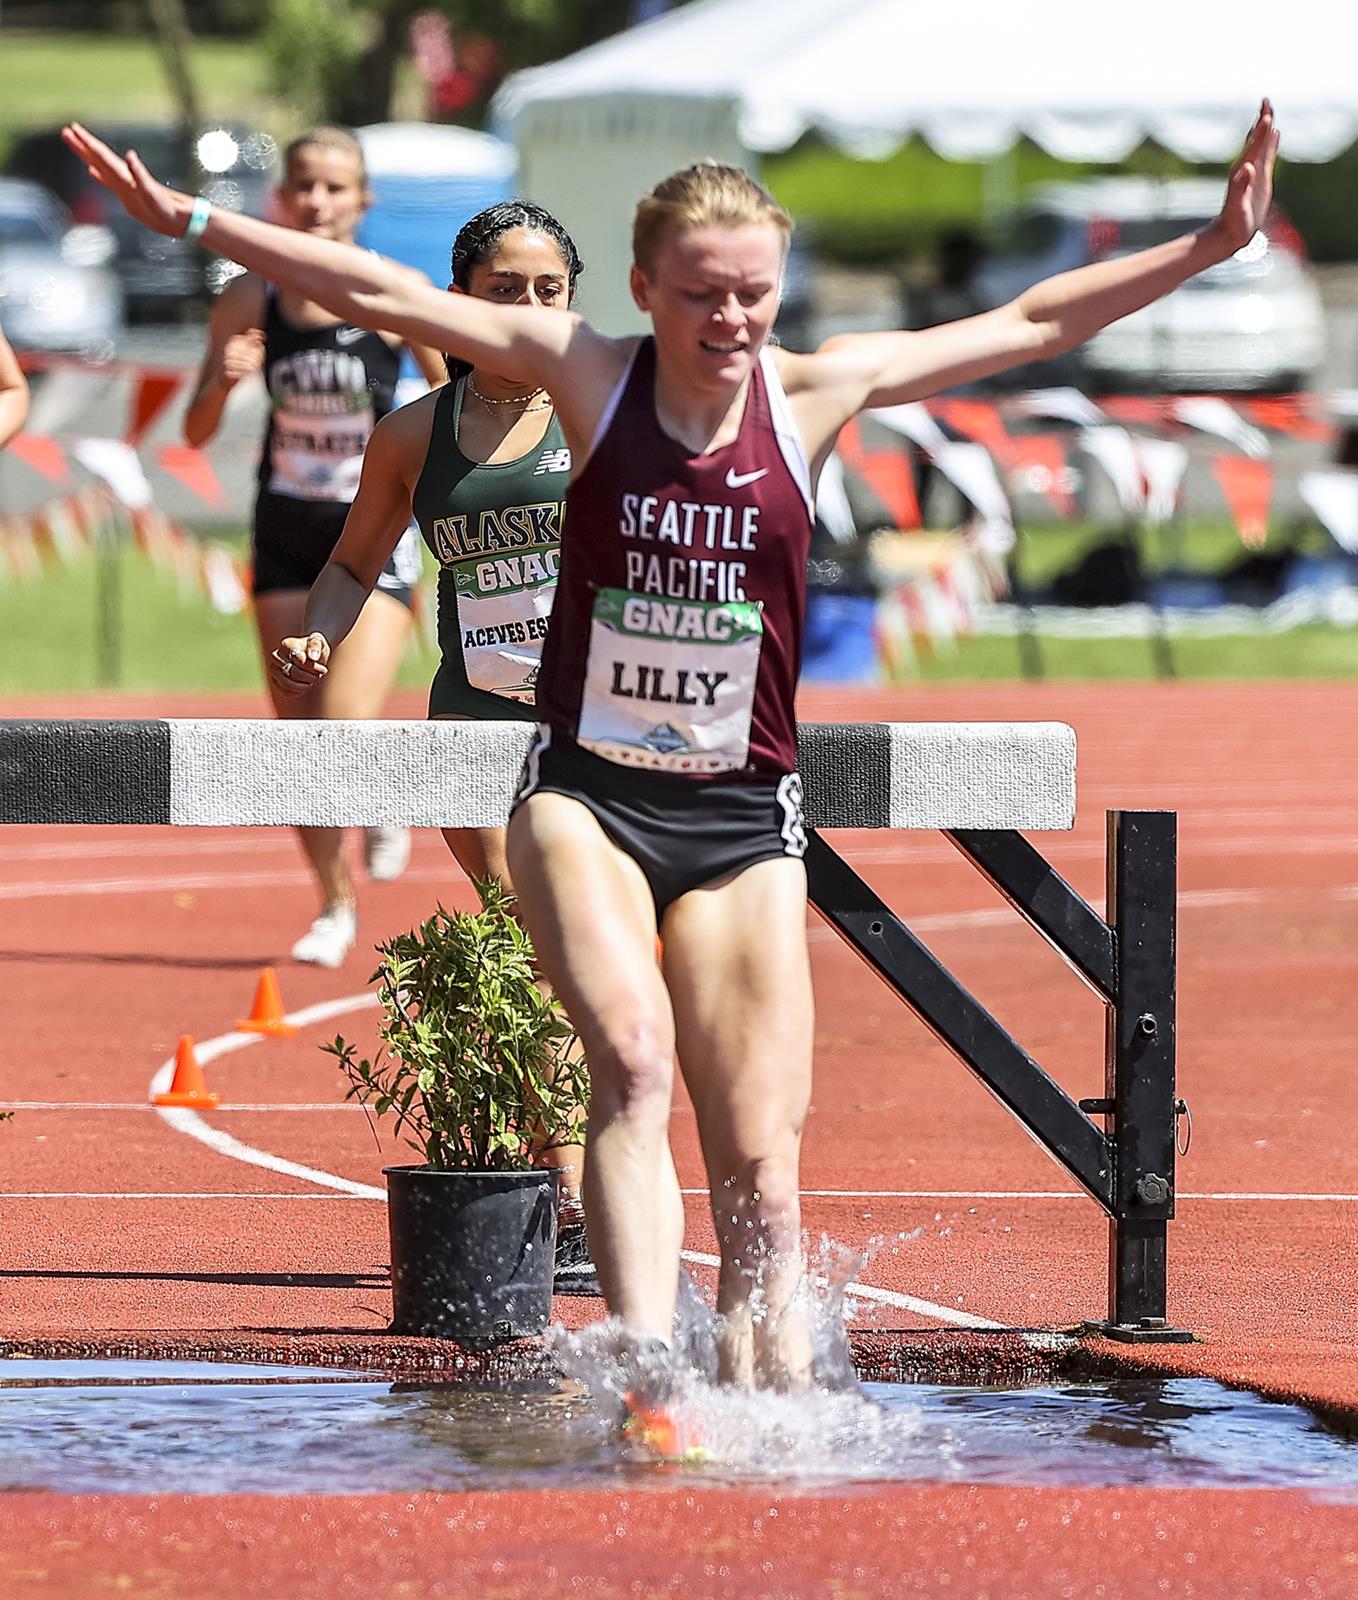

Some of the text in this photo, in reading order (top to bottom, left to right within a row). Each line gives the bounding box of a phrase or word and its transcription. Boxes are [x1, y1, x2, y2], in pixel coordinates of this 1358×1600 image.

[433, 500, 567, 564] ALASK
[619, 493, 760, 550] SEATTLE
[475, 549, 561, 593] GNAC
[626, 551, 747, 603] PACIFIC
[464, 622, 526, 648] ACEVES
[622, 597, 733, 640] GNAC
[610, 662, 728, 705] LILLY
